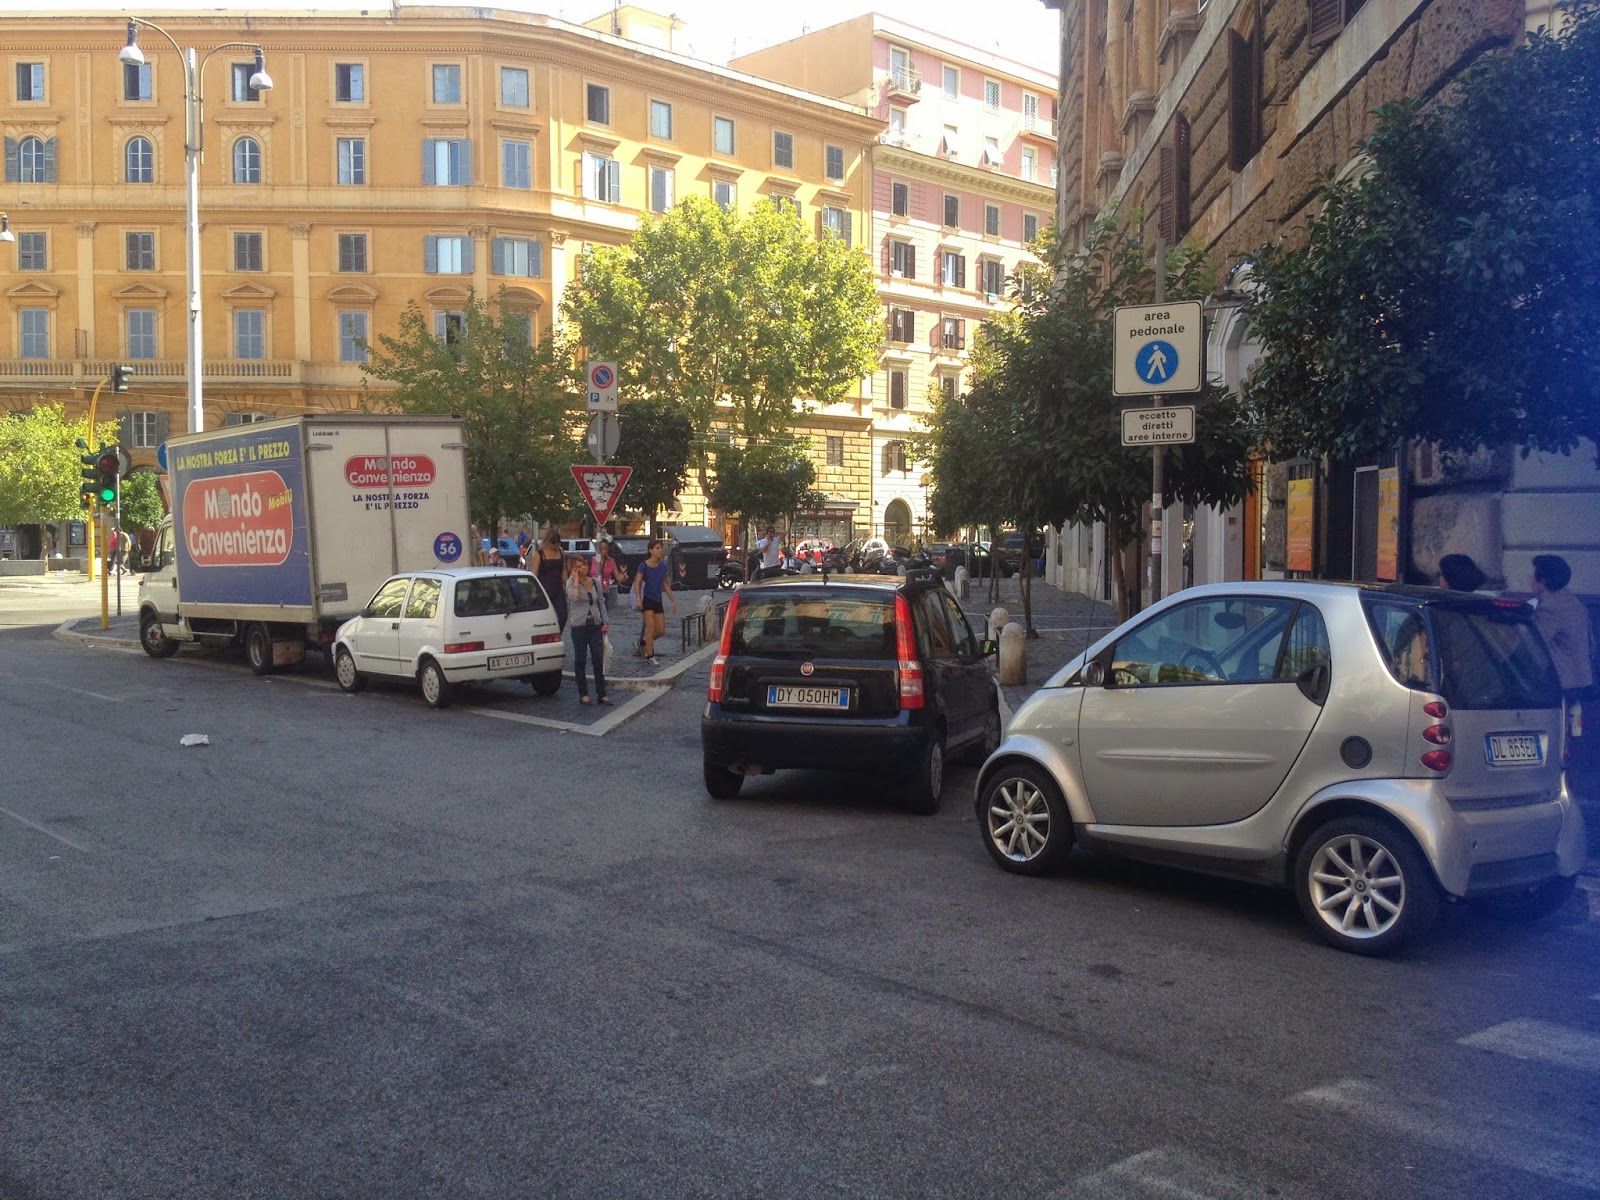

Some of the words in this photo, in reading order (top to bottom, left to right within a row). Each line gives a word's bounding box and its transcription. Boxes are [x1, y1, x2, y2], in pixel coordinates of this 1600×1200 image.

[1144, 311, 1170, 321] area
[1129, 324, 1185, 338] pedonale
[1139, 411, 1176, 420] eccetto
[1142, 421, 1173, 430] diretti
[1128, 433, 1149, 442] aree
[1152, 432, 1188, 440] interne
[176, 456, 185, 470] LA
[187, 453, 212, 469] NOSTRA
[214, 449, 238, 465] FORZA
[249, 446, 256, 460] IL
[258, 441, 290, 459] PREZZO
[349, 470, 431, 483] Convenienza
[268, 488, 293, 511] Mobili
[403, 492, 430, 500] FORZA
[375, 502, 382, 510] IL
[385, 502, 419, 510] PREZZO
[190, 522, 287, 556] Convenienza
[439, 543, 457, 555] 56
[778, 689, 793, 702] DY
[798, 689, 839, 704] 050HM
[1491, 738, 1506, 758] DL
